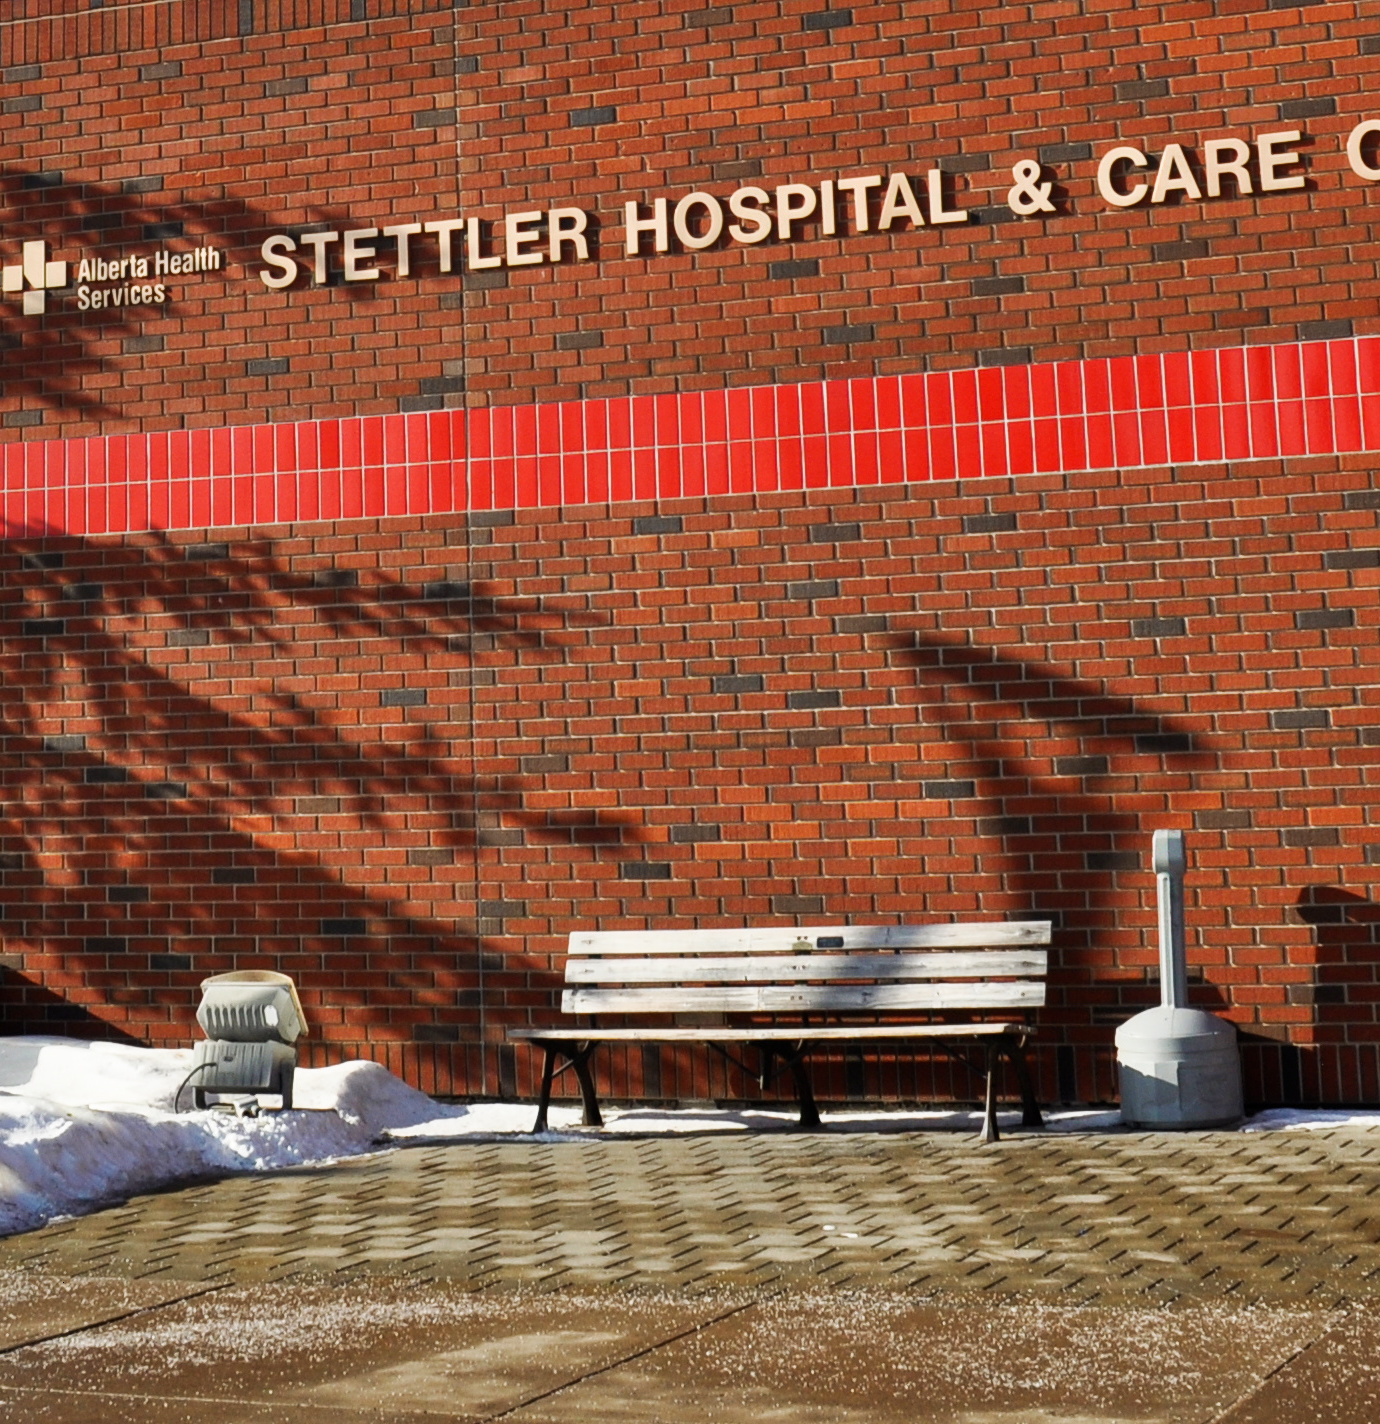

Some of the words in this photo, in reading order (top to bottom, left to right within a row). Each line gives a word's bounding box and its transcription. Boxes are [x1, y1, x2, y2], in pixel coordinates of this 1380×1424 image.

[259, 206, 589, 289] STETTLER
[624, 168, 968, 256] HOSPITAL
[1007, 159, 1056, 216] &
[1096, 130, 1305, 208] CARE
[77, 254, 148, 283] Alberta
[155, 245, 220, 276] Health
[77, 282, 165, 311] Services
